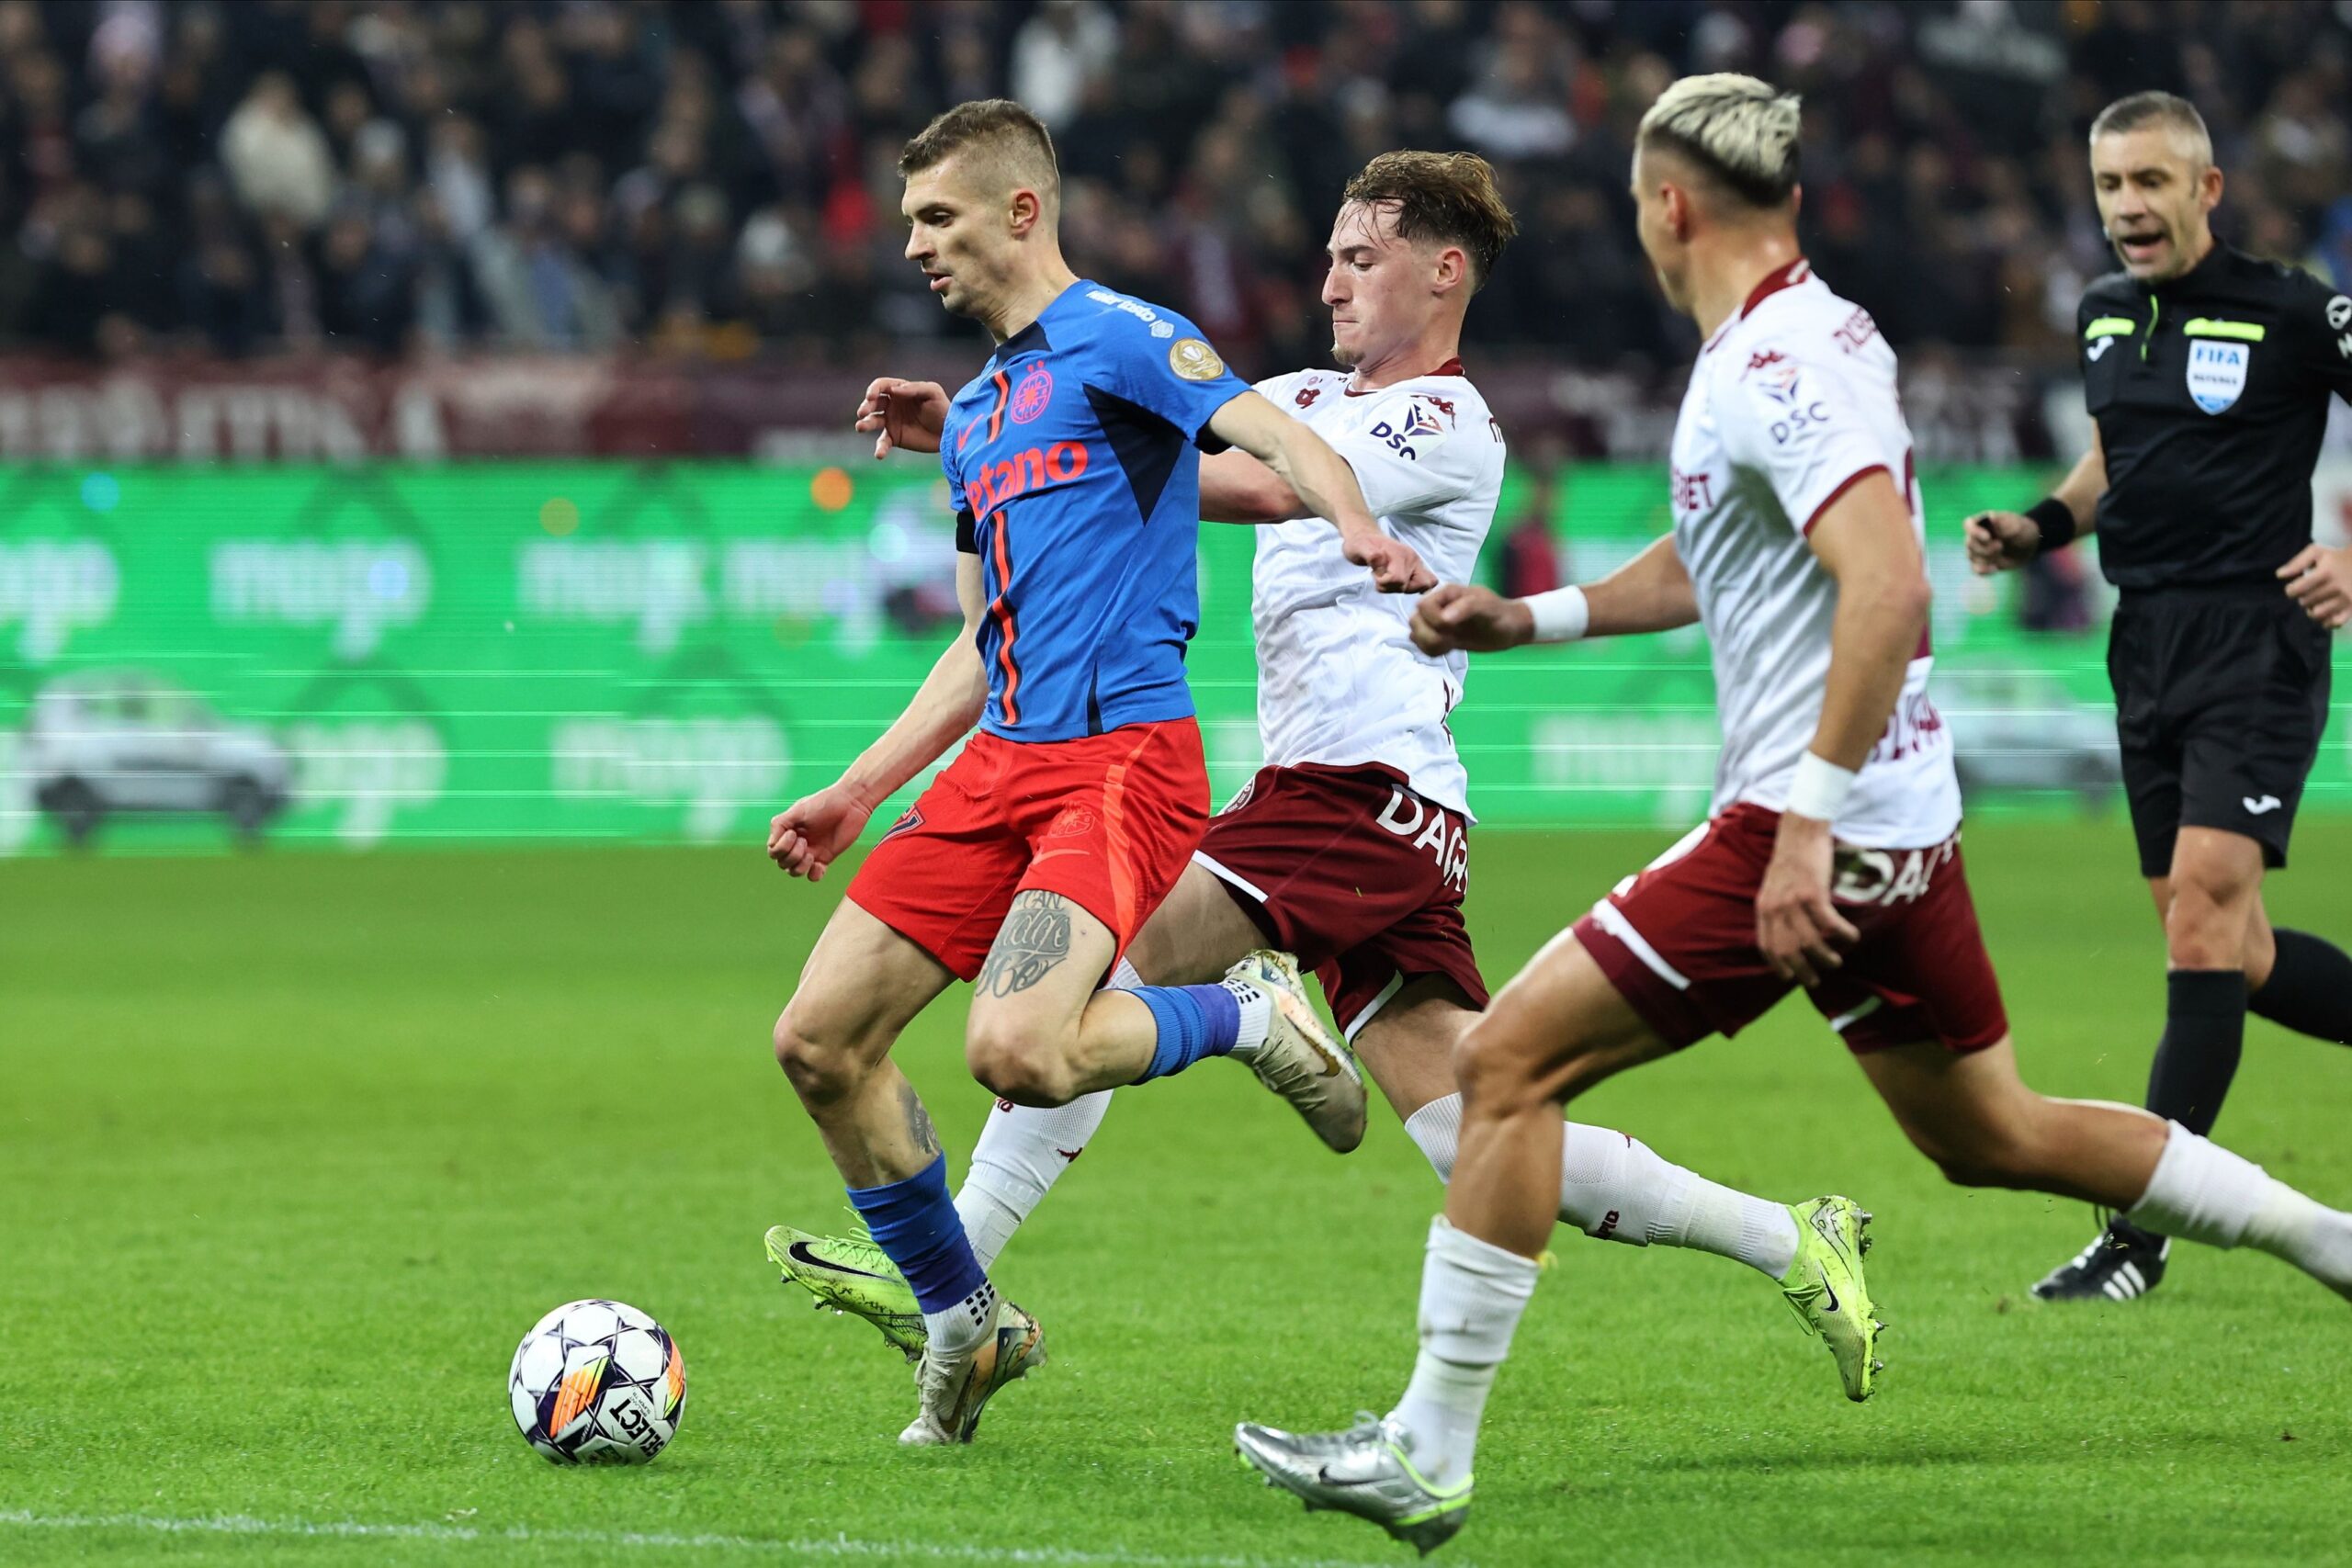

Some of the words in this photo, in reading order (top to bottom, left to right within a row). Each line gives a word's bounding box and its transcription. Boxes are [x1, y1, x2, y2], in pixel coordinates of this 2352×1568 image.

[2195, 345, 2241, 366] FIFA
[1370, 421, 1416, 461] DSC
[1770, 400, 1829, 445] DSC
[965, 440, 1089, 522] etano
[609, 1398, 665, 1458] SELECT
